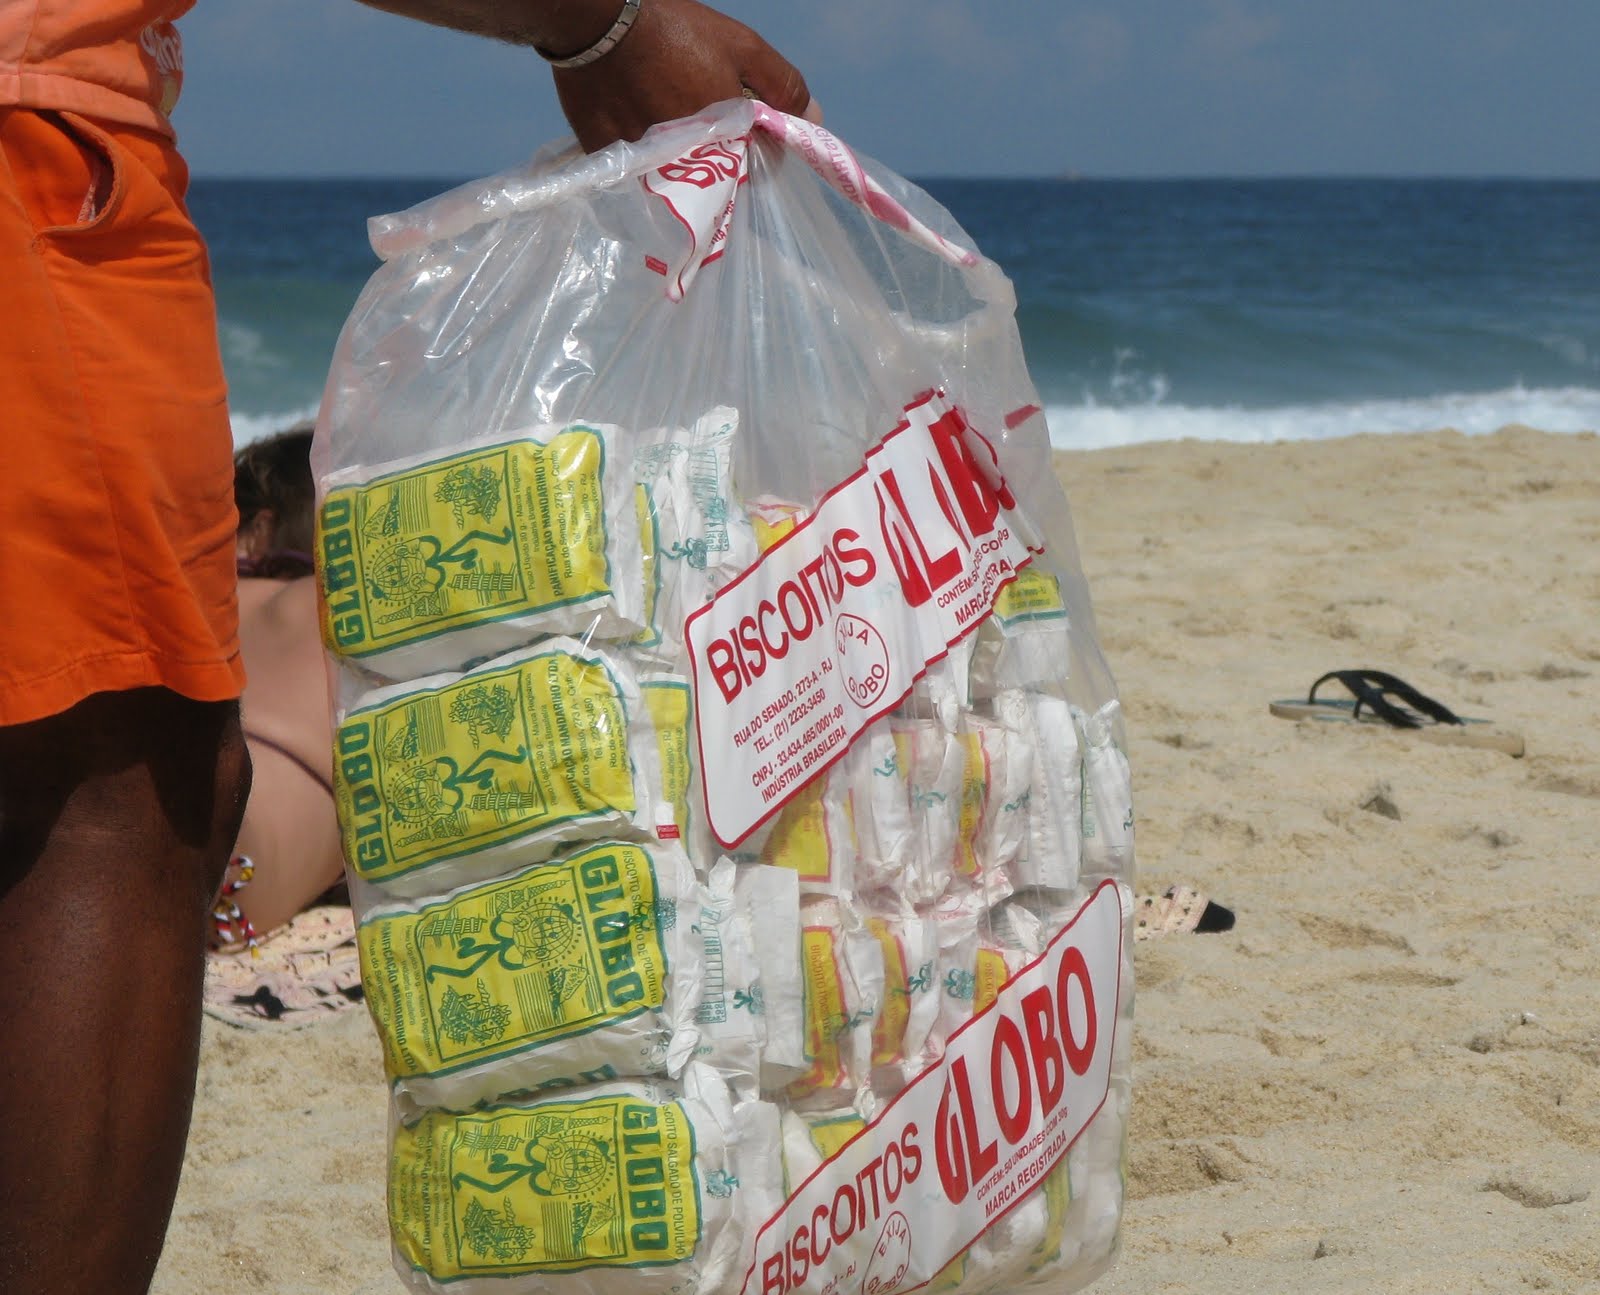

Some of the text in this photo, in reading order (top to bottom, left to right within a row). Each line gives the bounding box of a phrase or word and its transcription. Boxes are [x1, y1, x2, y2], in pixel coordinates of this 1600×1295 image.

[534, 466, 553, 528] MANDARINO
[553, 491, 564, 508] 273
[321, 499, 364, 648] GLOBO
[542, 529, 564, 596] PANIFICAÇÃO
[560, 546, 569, 558] do
[562, 558, 573, 578] Rua
[706, 528, 876, 705] BISCOITOS
[549, 684, 570, 747] MANDARINO
[571, 710, 582, 728] 273
[733, 728, 751, 748] RUA
[750, 716, 763, 734] DO
[761, 690, 798, 719] SENADO,
[795, 671, 820, 697] 273-A
[821, 657, 833, 675] RJ
[753, 688, 826, 754] TEL.: (21) 2232-3450
[608, 752, 618, 767] Rio
[752, 764, 774, 787] CNPJ
[761, 725, 848, 804] INDÚSTRIA BRASILEIRA
[339, 721, 386, 871] GLOBO
[622, 849, 641, 893] BISCOITO
[579, 855, 645, 1008] GLOBO
[636, 943, 647, 956] DE
[641, 956, 660, 1004] POLVILHO
[762, 946, 1098, 1295] BISCOITOS GLOBO
[622, 1104, 669, 1251] GLOBO
[664, 1141, 681, 1189] SALGADO
[985, 1130, 1067, 1218] MARCA REGISTRADA
[671, 1190, 682, 1204] DE
[670, 1206, 687, 1254] POLVILHO
